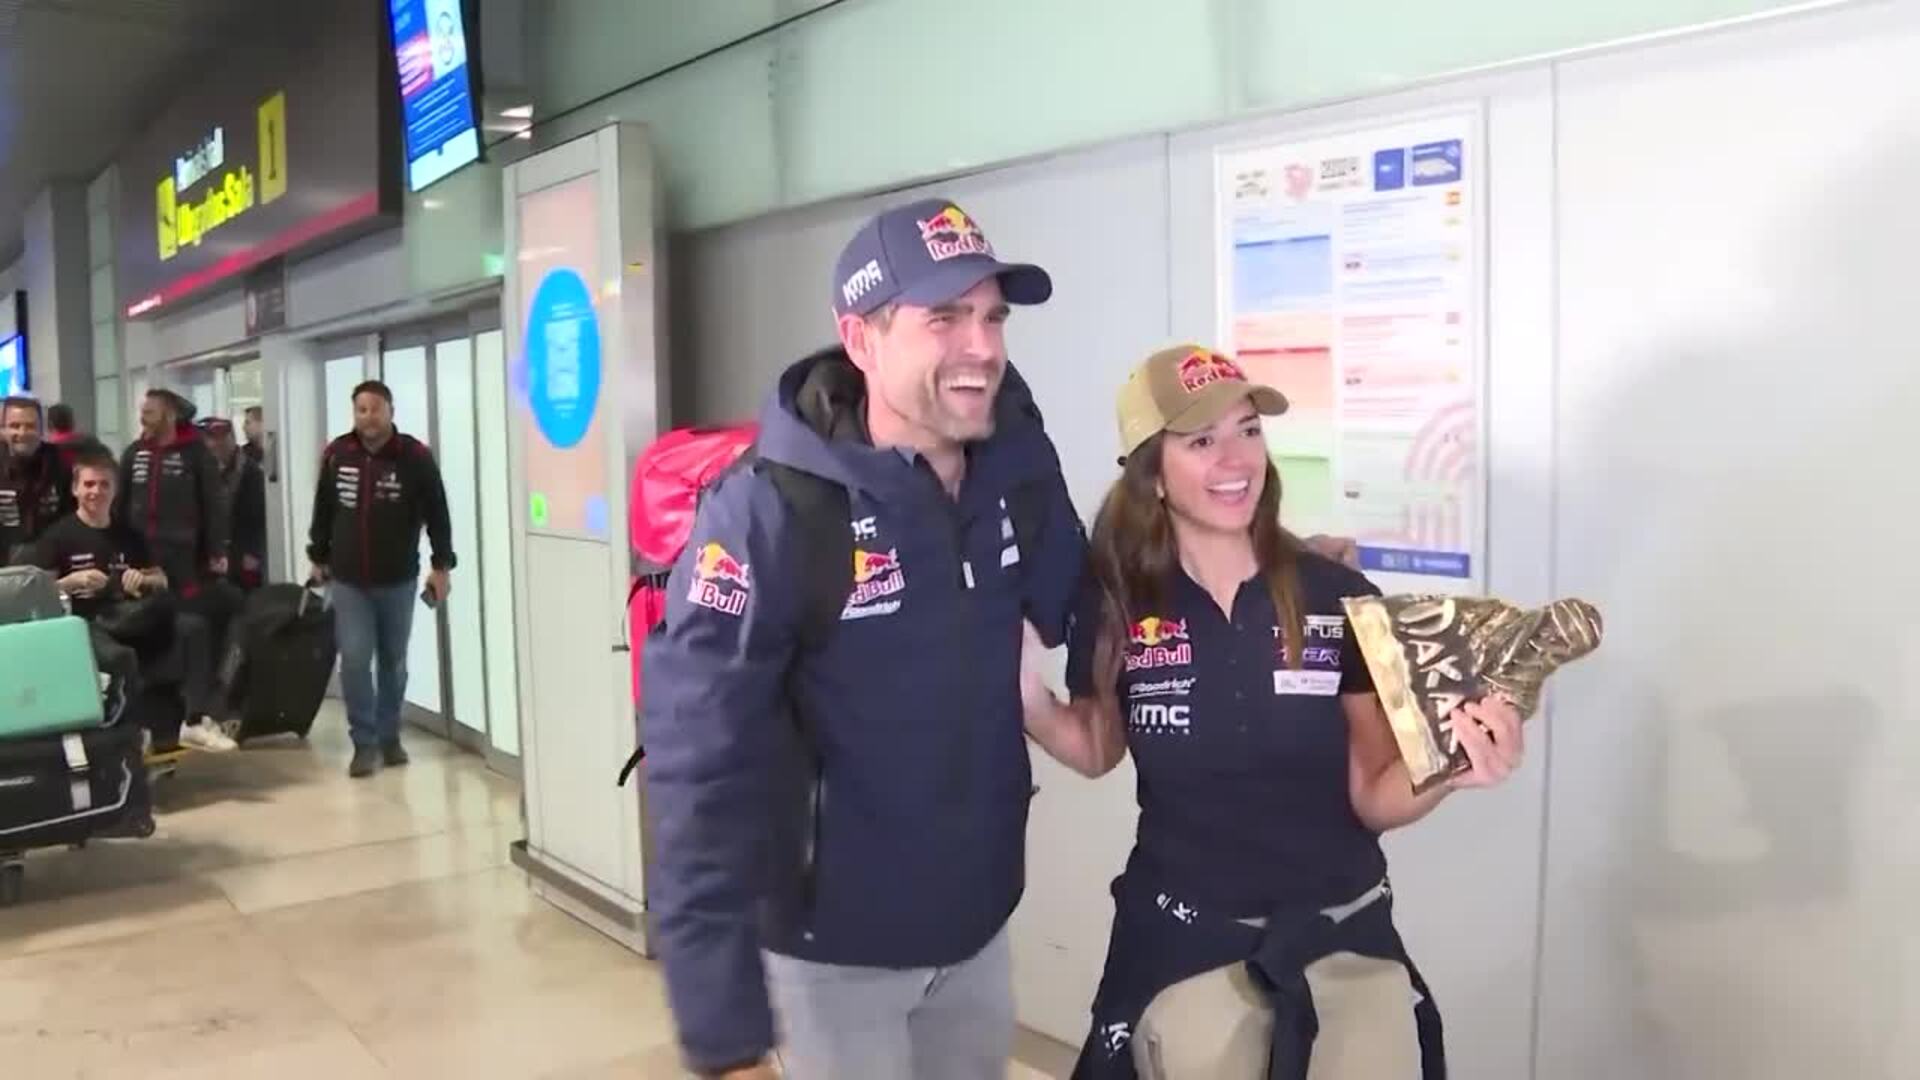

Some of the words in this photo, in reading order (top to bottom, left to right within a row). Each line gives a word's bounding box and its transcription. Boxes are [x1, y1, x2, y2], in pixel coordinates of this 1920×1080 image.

[926, 235, 970, 261] Red
[1182, 364, 1222, 393] Red
[700, 582, 748, 616] Bull
[865, 569, 905, 602] Bull
[1153, 643, 1192, 668] Bull
